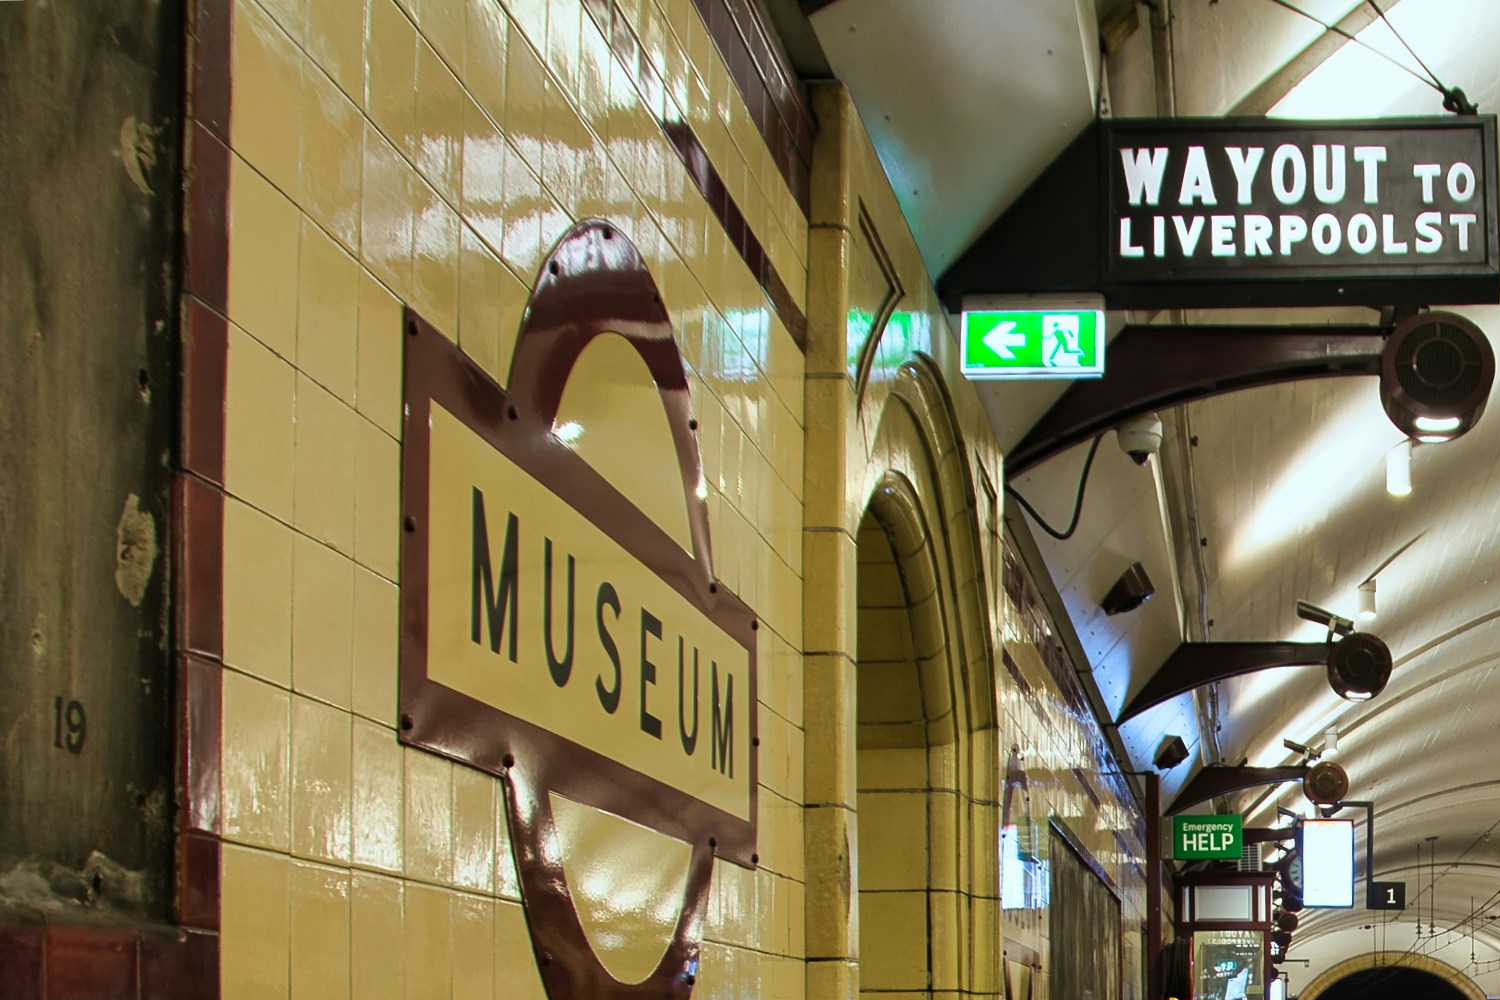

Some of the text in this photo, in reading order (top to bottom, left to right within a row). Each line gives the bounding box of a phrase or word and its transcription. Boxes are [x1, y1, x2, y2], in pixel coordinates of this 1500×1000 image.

[1414, 162, 1475, 203] TO
[471, 486, 737, 781] MUSEUM
[53, 695, 88, 756] 19
[1182, 823, 1233, 833] Emergency
[1182, 833, 1234, 851] HELP
[1387, 888, 1397, 904] 1
